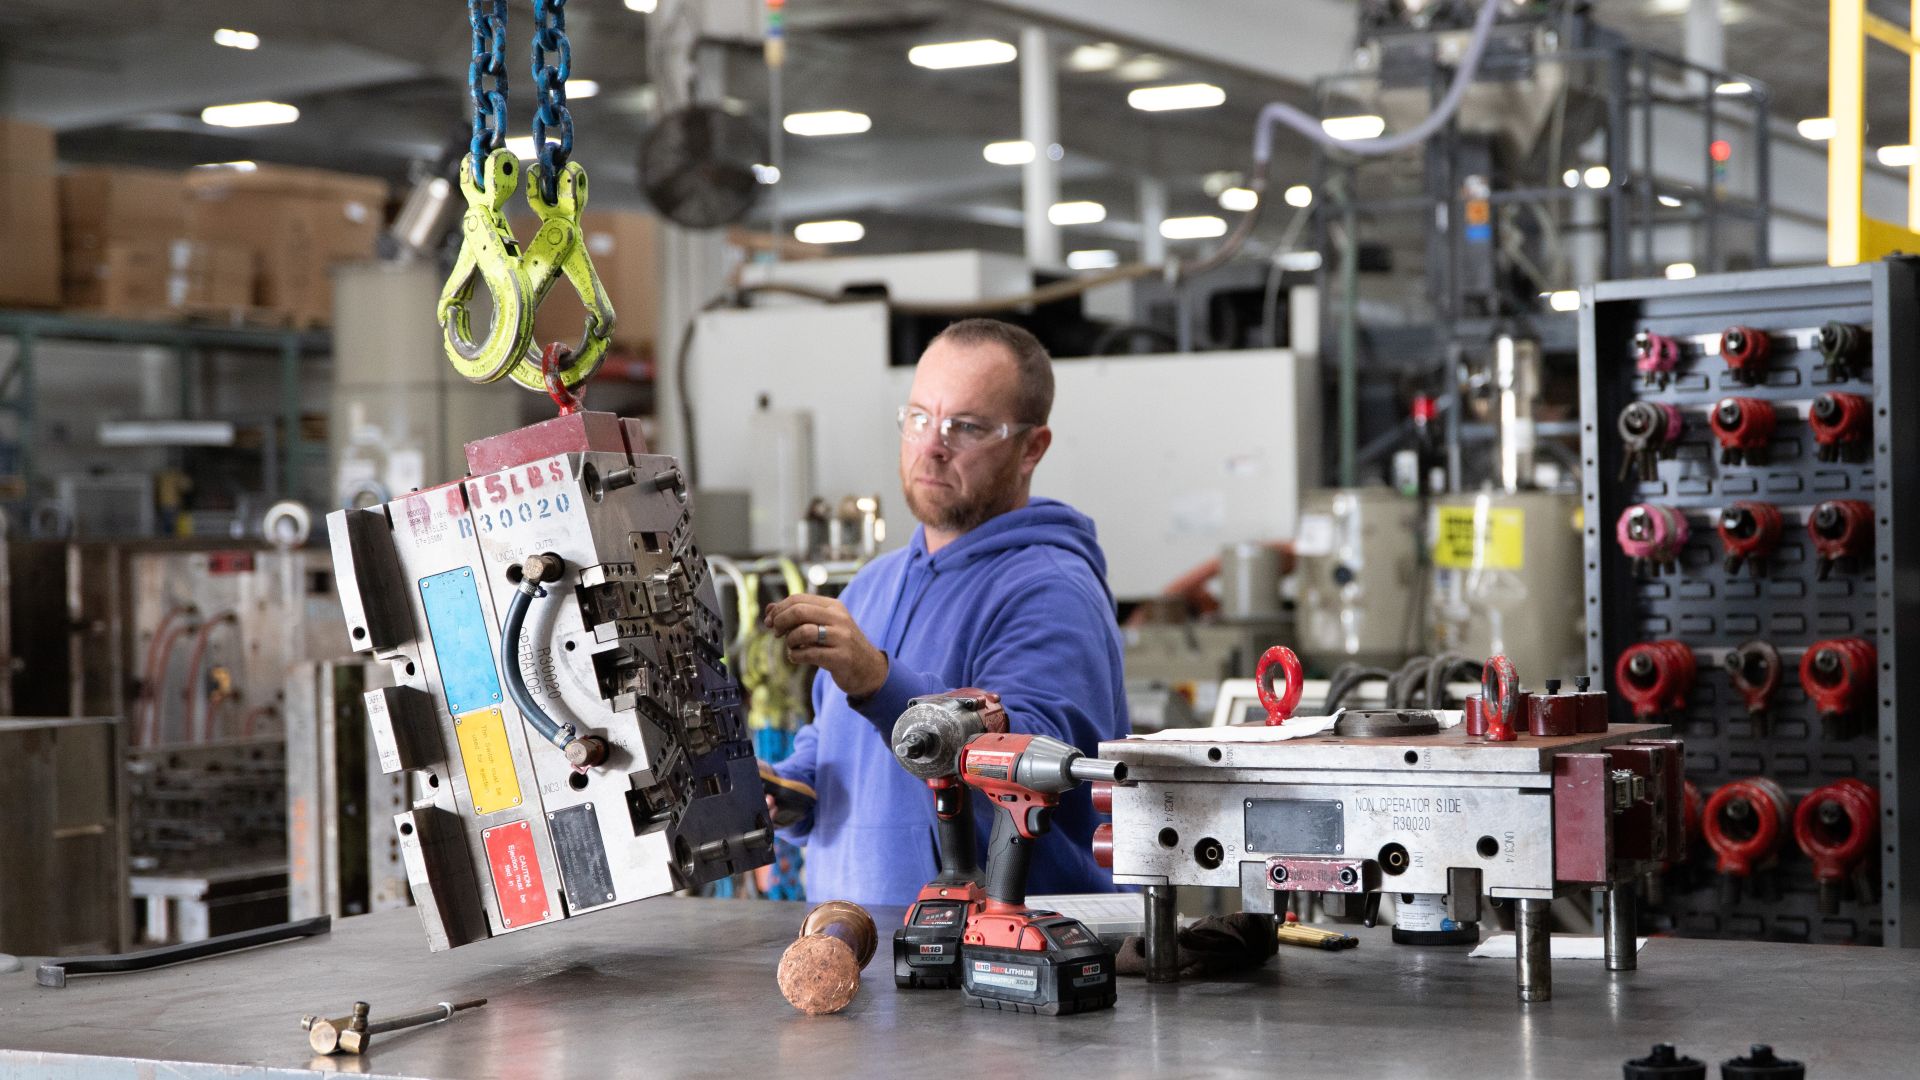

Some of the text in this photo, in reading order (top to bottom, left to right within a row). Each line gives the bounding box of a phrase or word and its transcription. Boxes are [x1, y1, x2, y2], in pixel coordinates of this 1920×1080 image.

[458, 493, 570, 539] R30020
[537, 646, 562, 700] R30020
[1355, 797, 1462, 813] NON OPERATOR SIDE
[1393, 816, 1431, 831] R30020
[1504, 831, 1515, 863] UNC3/4
[519, 855, 532, 888] CAUTION
[920, 945, 942, 954] M18
[975, 962, 1034, 977] M18 REDLITHIUM
[1083, 964, 1100, 975] M18
